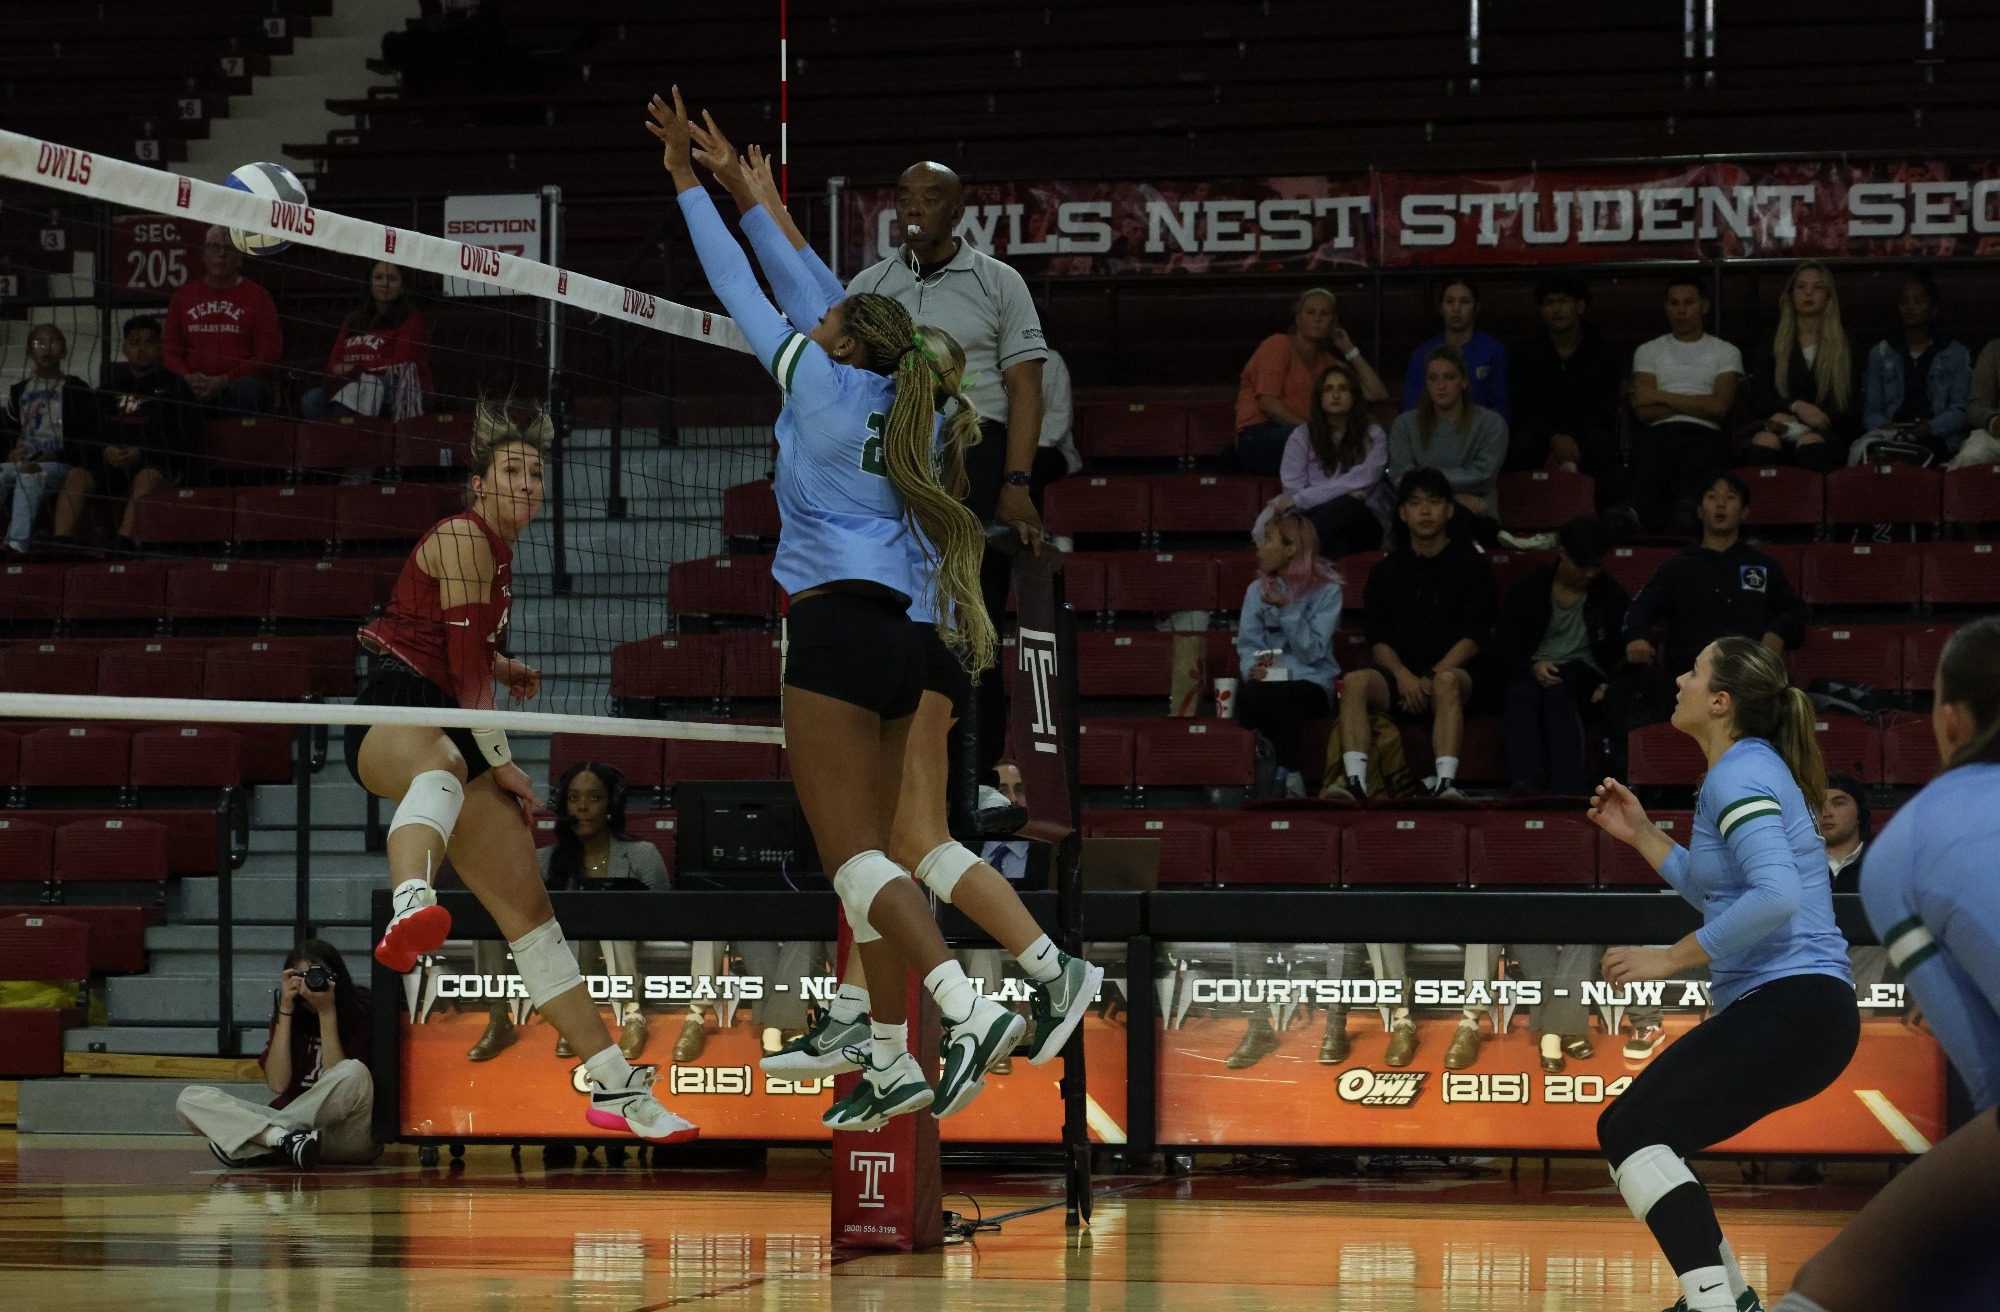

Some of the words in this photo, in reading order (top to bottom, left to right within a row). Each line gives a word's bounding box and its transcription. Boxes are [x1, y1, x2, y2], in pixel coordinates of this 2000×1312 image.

[37, 143, 92, 185] OWLS
[134, 223, 182, 243] SEC.
[271, 200, 315, 236] OWLS
[448, 218, 537, 235] SECTION
[1144, 195, 1371, 254] NEST
[1400, 185, 1815, 247] STUDENT
[127, 249, 189, 288] 205
[460, 244, 500, 277] OWLS
[187, 300, 245, 321] TEMPLE
[622, 287, 656, 319] OWLS
[644, 975, 764, 1000] SEATS
[1192, 979, 1403, 1004] COURTSIDE
[1414, 979, 1543, 1005] SEATS
[1581, 980, 1666, 1006] NOW
[670, 1064, 753, 1096] (215)
[1337, 1068, 1418, 1101] OWL
[1375, 1073, 1426, 1081] TEMPLE
[1442, 1071, 1530, 1105] (215)
[1361, 1096, 1411, 1105] CLUB
[844, 1225, 862, 1233] (800)
